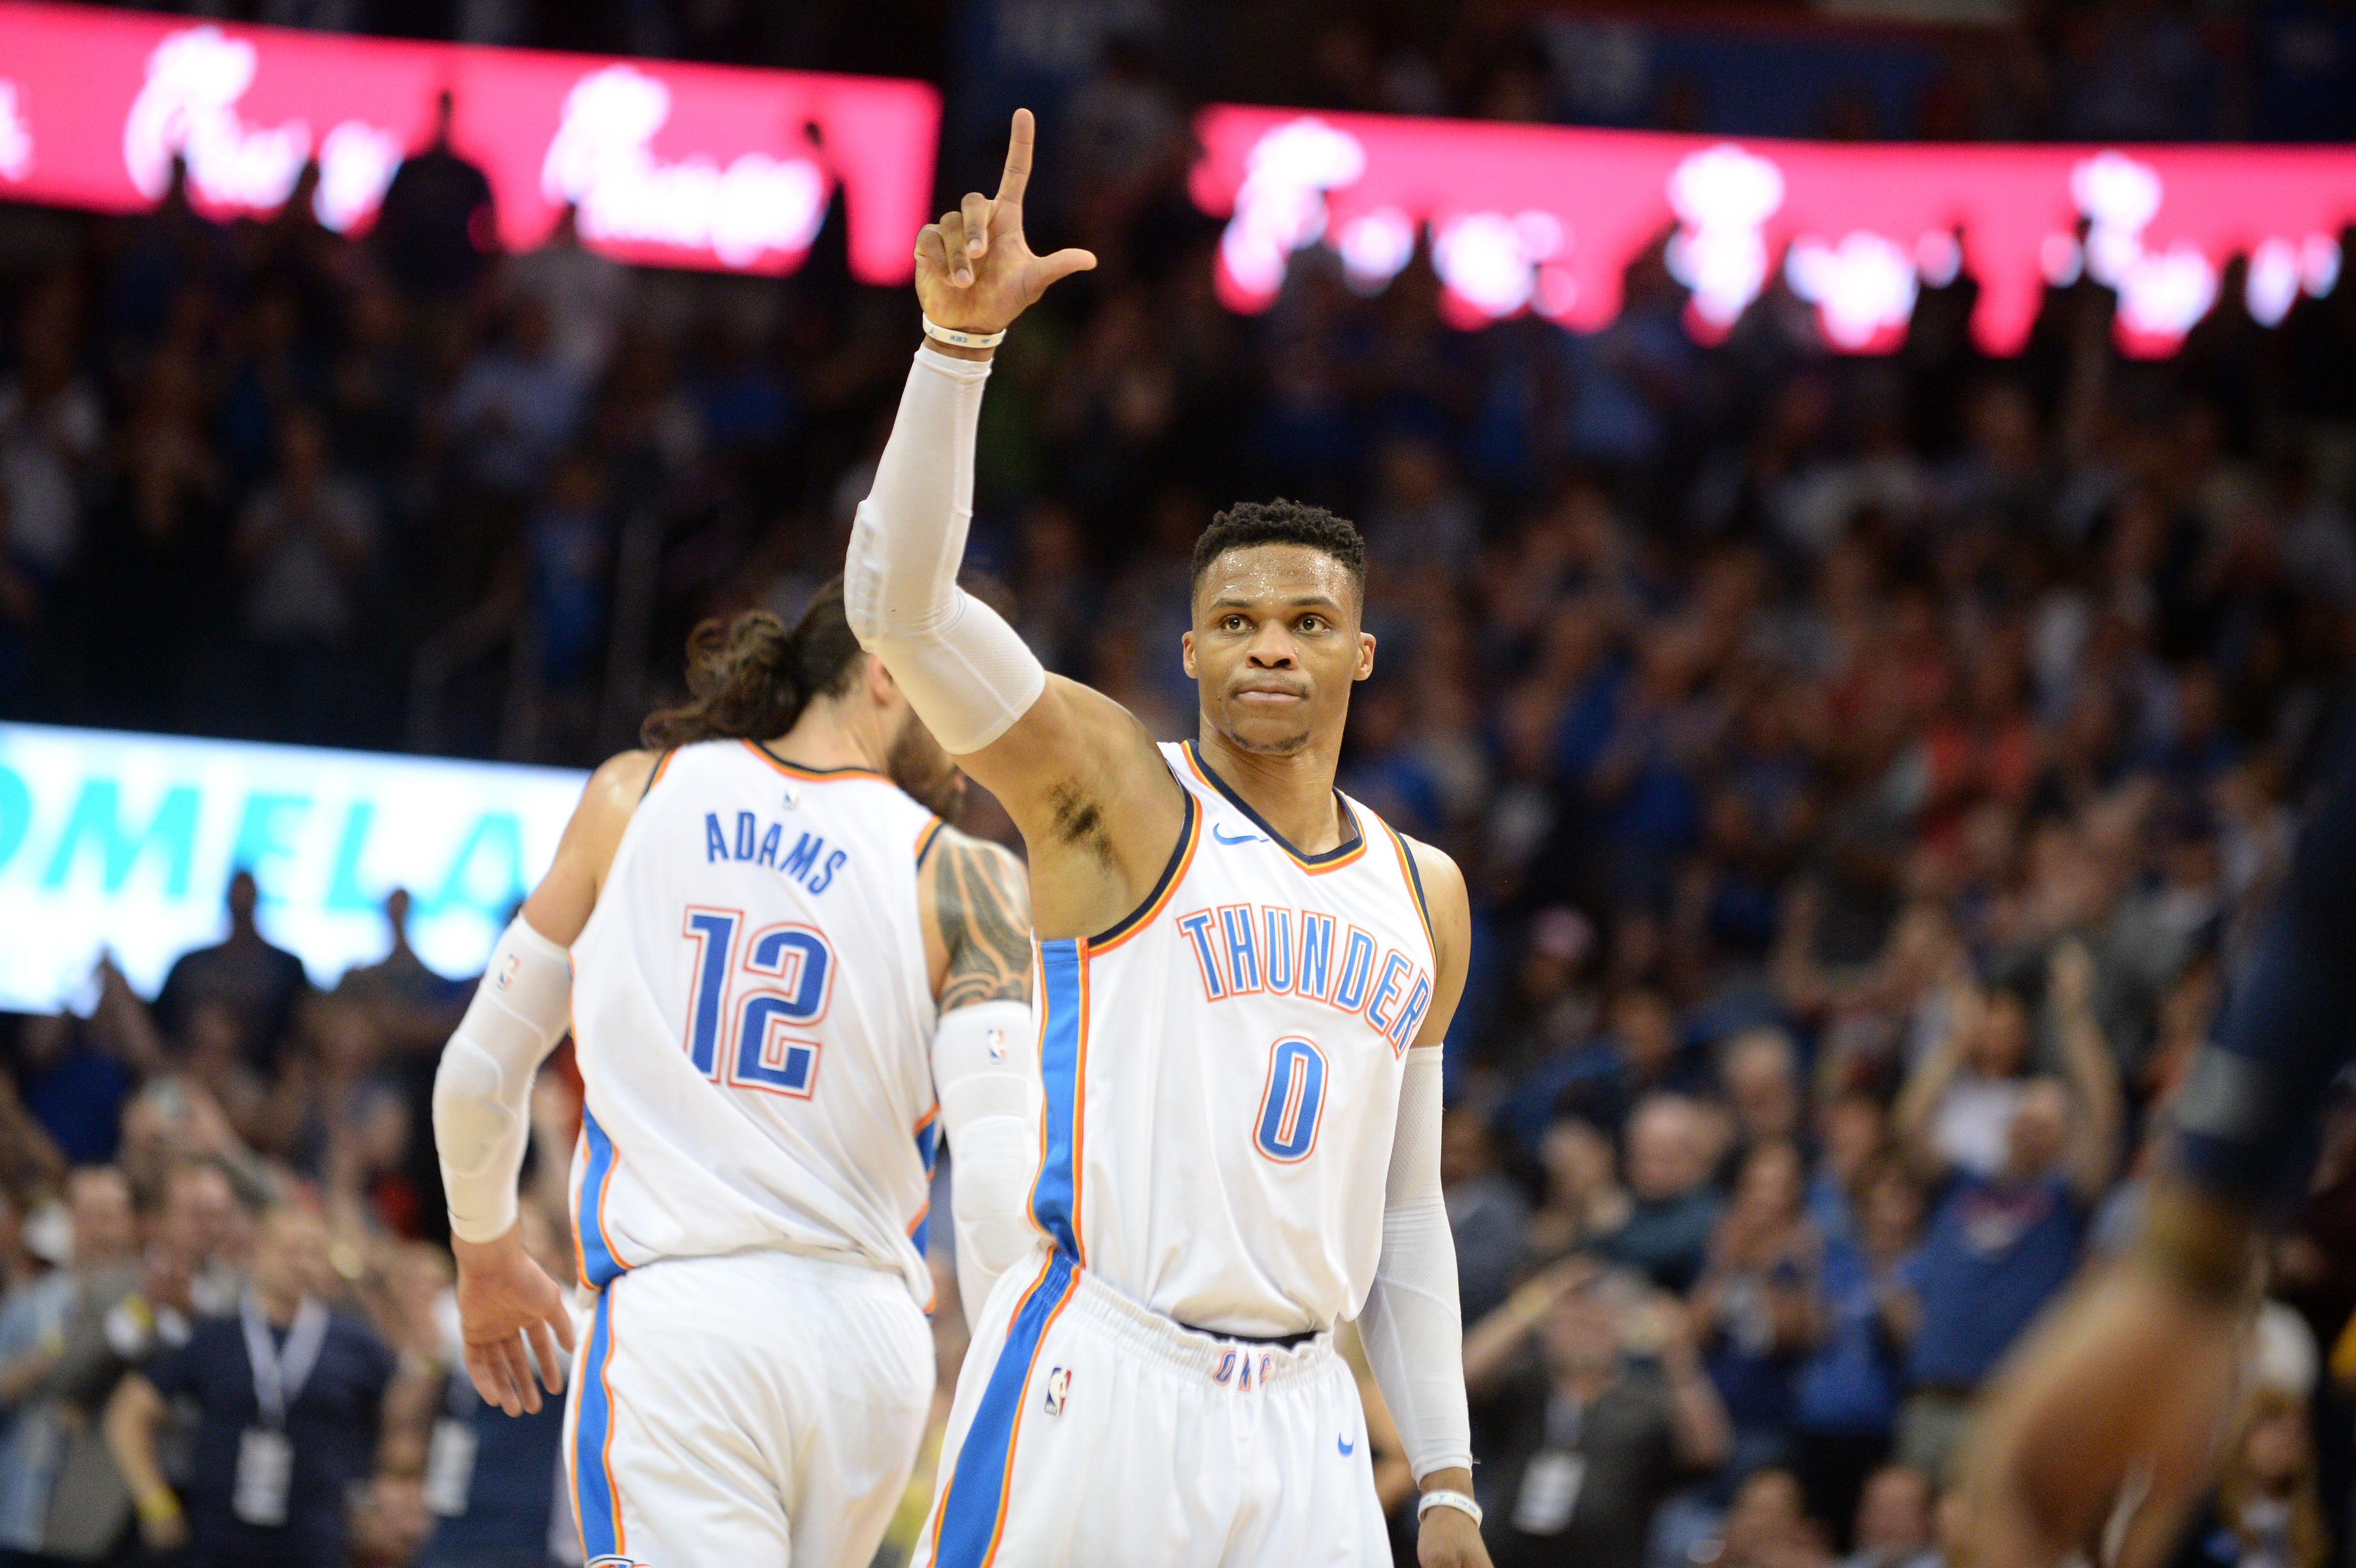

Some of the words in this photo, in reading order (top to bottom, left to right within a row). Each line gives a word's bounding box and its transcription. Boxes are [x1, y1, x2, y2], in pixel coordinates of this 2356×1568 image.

[705, 811, 847, 895] ADAMS
[682, 904, 837, 1101] 12
[1176, 902, 1432, 1061] THUNDER
[1253, 1035, 1329, 1165] 0
